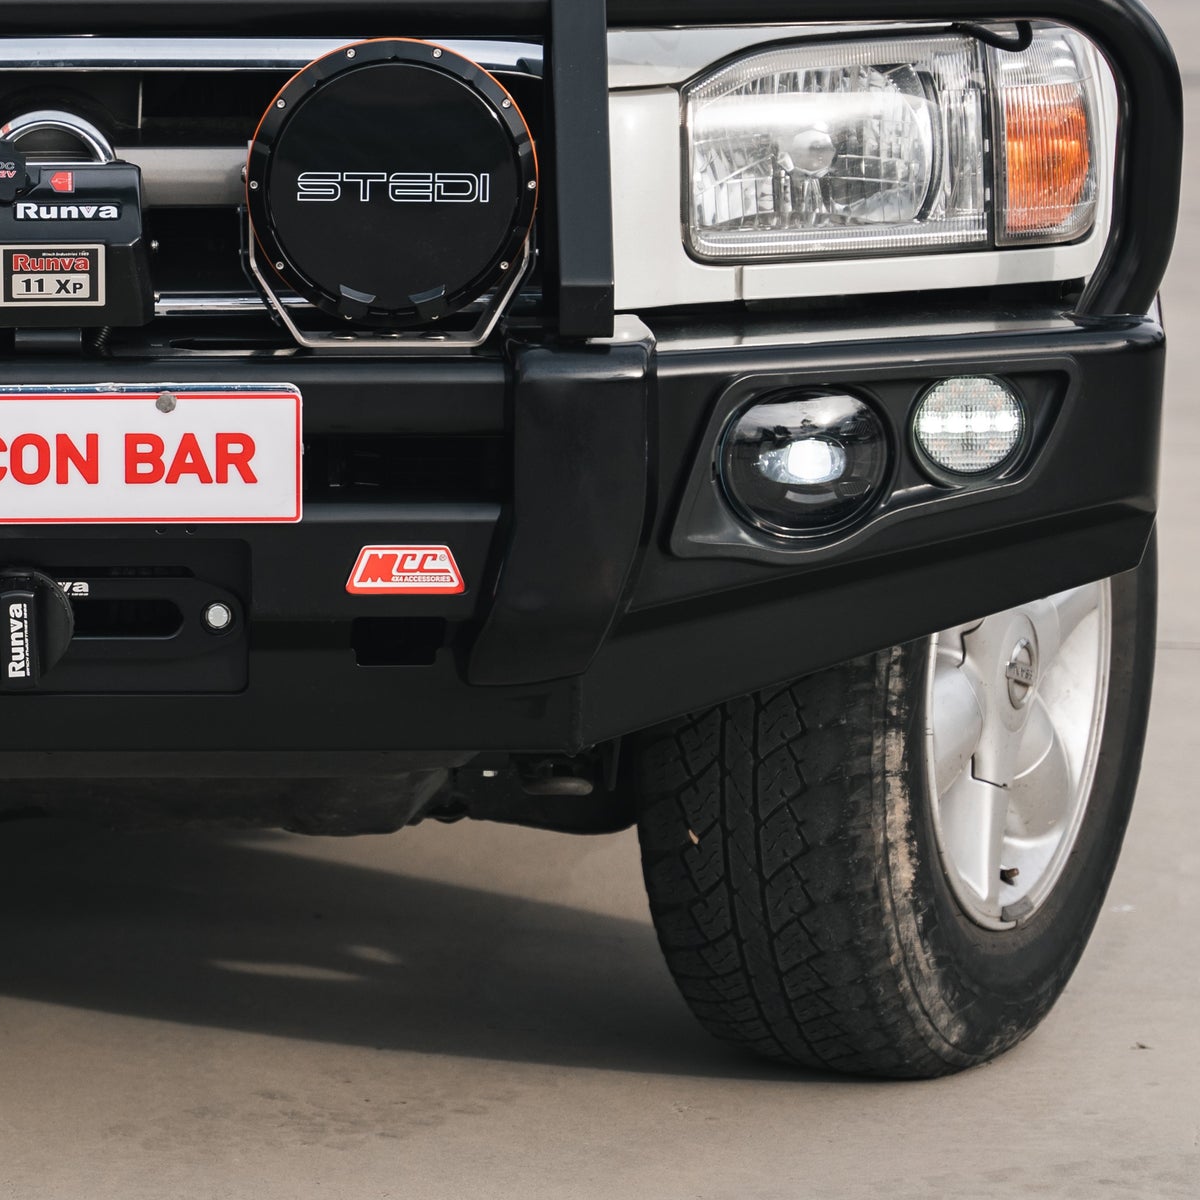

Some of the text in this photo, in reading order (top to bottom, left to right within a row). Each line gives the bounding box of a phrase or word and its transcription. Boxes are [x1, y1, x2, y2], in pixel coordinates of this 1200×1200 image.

[297, 172, 489, 203] STEDI
[16, 203, 119, 219] Runva
[12, 253, 90, 272] Runva
[21, 278, 45, 293] 11
[124, 432, 258, 485] BAR
[358, 553, 452, 583] MCC
[8, 603, 26, 678] Runva
